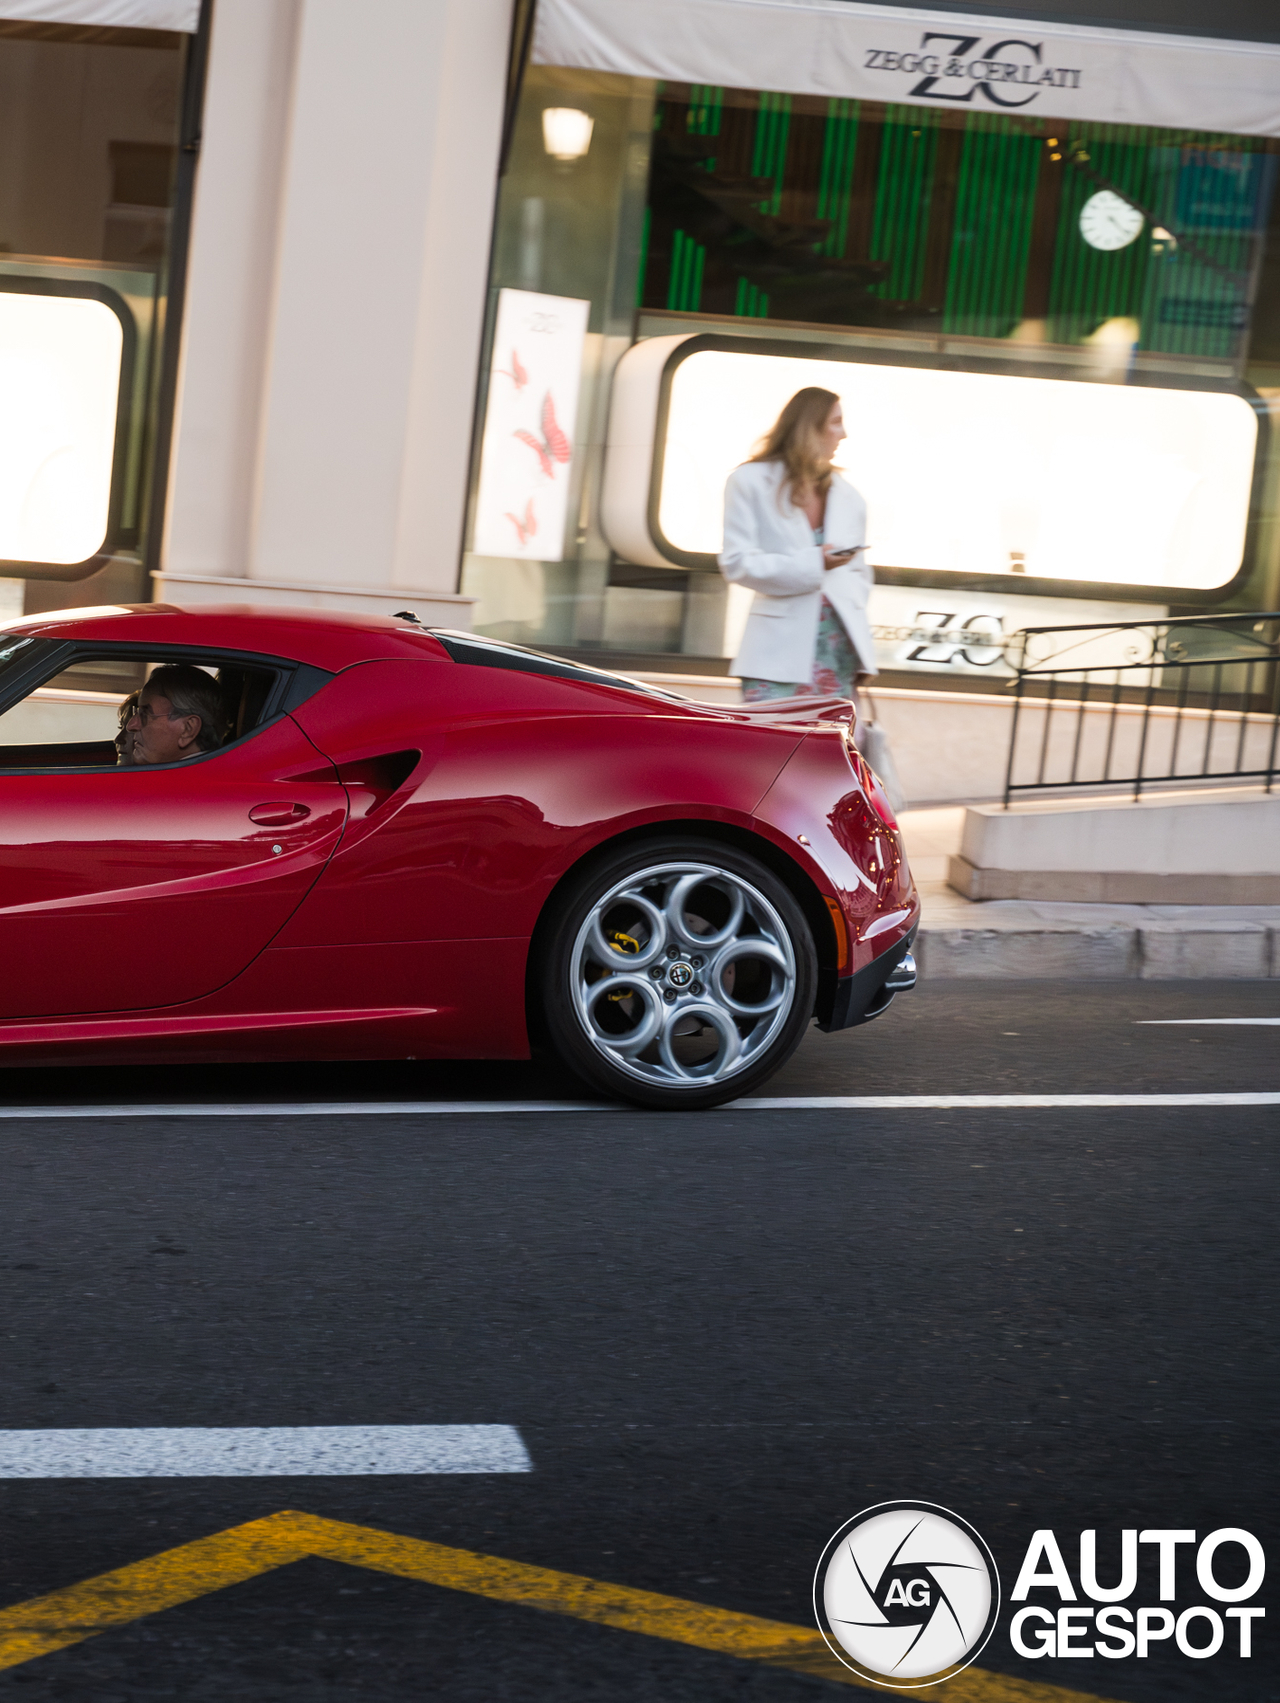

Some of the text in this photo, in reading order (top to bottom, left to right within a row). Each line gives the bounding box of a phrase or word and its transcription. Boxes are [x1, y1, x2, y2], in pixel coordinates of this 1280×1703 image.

[864, 49, 1082, 88] ZEGG & CERLATI
[907, 32, 1043, 107] ZC
[906, 611, 1004, 666] ZC
